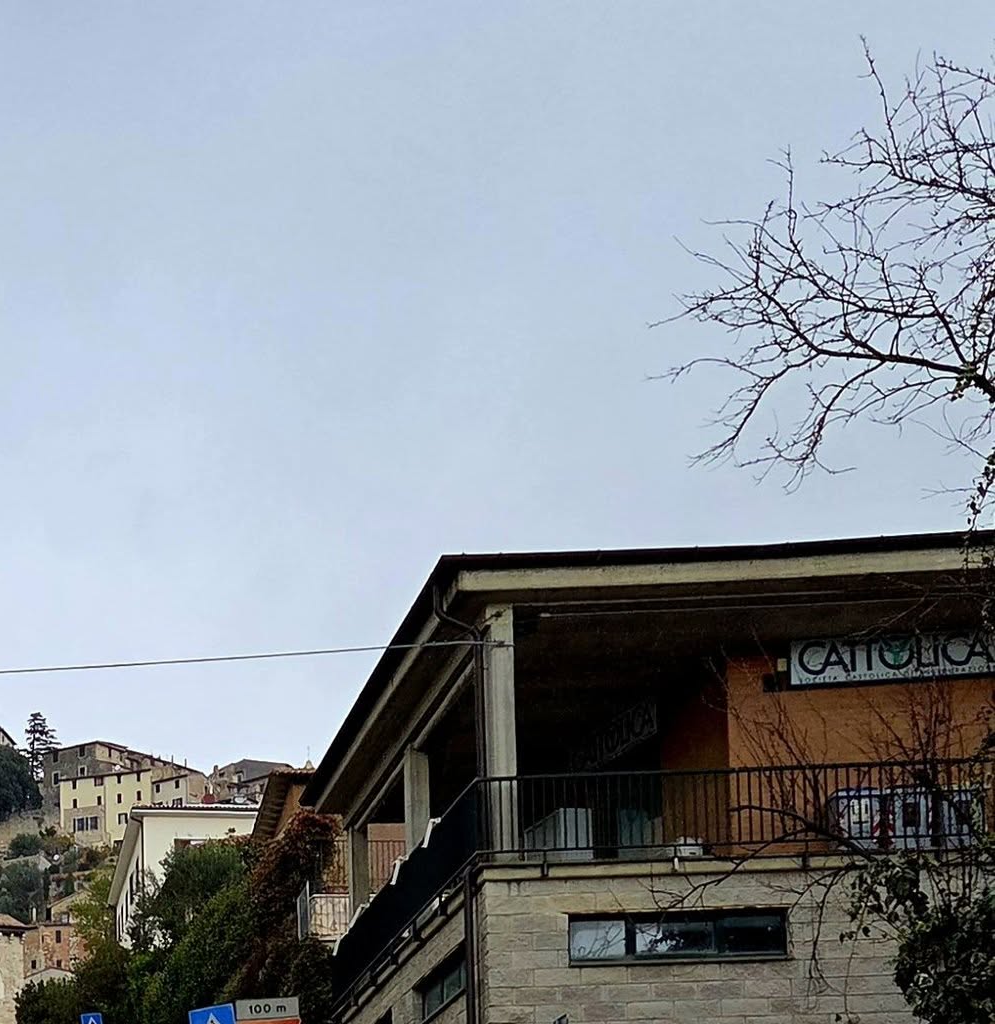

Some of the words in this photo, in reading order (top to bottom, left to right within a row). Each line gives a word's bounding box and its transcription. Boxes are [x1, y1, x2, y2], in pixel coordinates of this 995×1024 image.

[798, 632, 995, 676] CATTOLICA
[249, 1003, 271, 1014] 100
[276, 1005, 286, 1013] m
